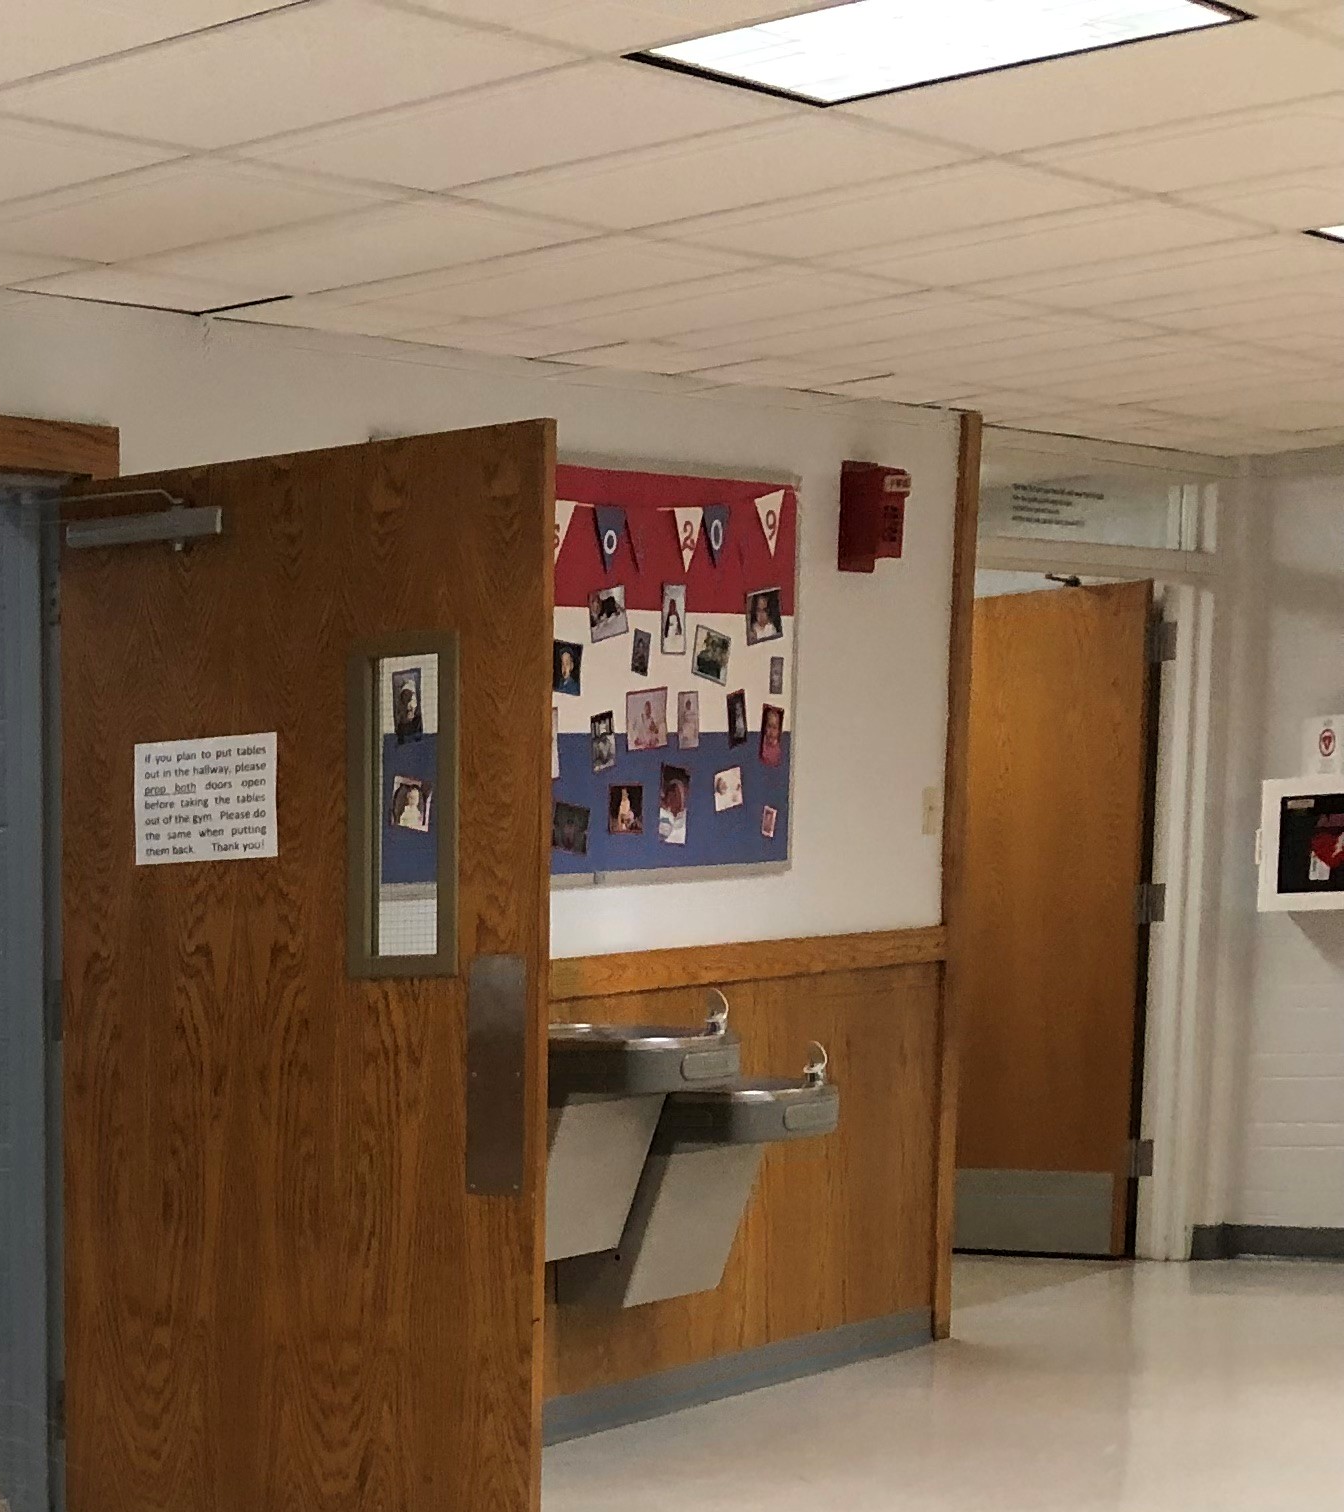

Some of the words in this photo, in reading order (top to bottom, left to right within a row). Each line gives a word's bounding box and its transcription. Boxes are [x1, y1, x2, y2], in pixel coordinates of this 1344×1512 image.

[155, 755, 172, 765] you
[176, 752, 197, 763] plan
[201, 750, 211, 759] to
[216, 749, 232, 758] put
[237, 745, 266, 756] tables
[144, 769, 160, 780] out
[163, 768, 171, 777] in
[175, 767, 190, 777] the
[235, 762, 266, 774] please
[175, 783, 196, 794] both
[205, 780, 232, 791] doors
[241, 778, 266, 789] open
[144, 800, 175, 810] before
[180, 797, 209, 809] taking
[215, 795, 230, 805] the
[237, 793, 265, 804] tables
[145, 816, 160, 826] out
[163, 814, 172, 825] of
[175, 813, 190, 823] the
[220, 810, 250, 820] Please
[253, 808, 266, 818] do
[145, 831, 161, 841] the
[167, 830, 191, 840] same
[199, 828, 224, 838] when
[231, 825, 267, 836] putting
[146, 846, 170, 856] them
[212, 842, 239, 852] Thank
